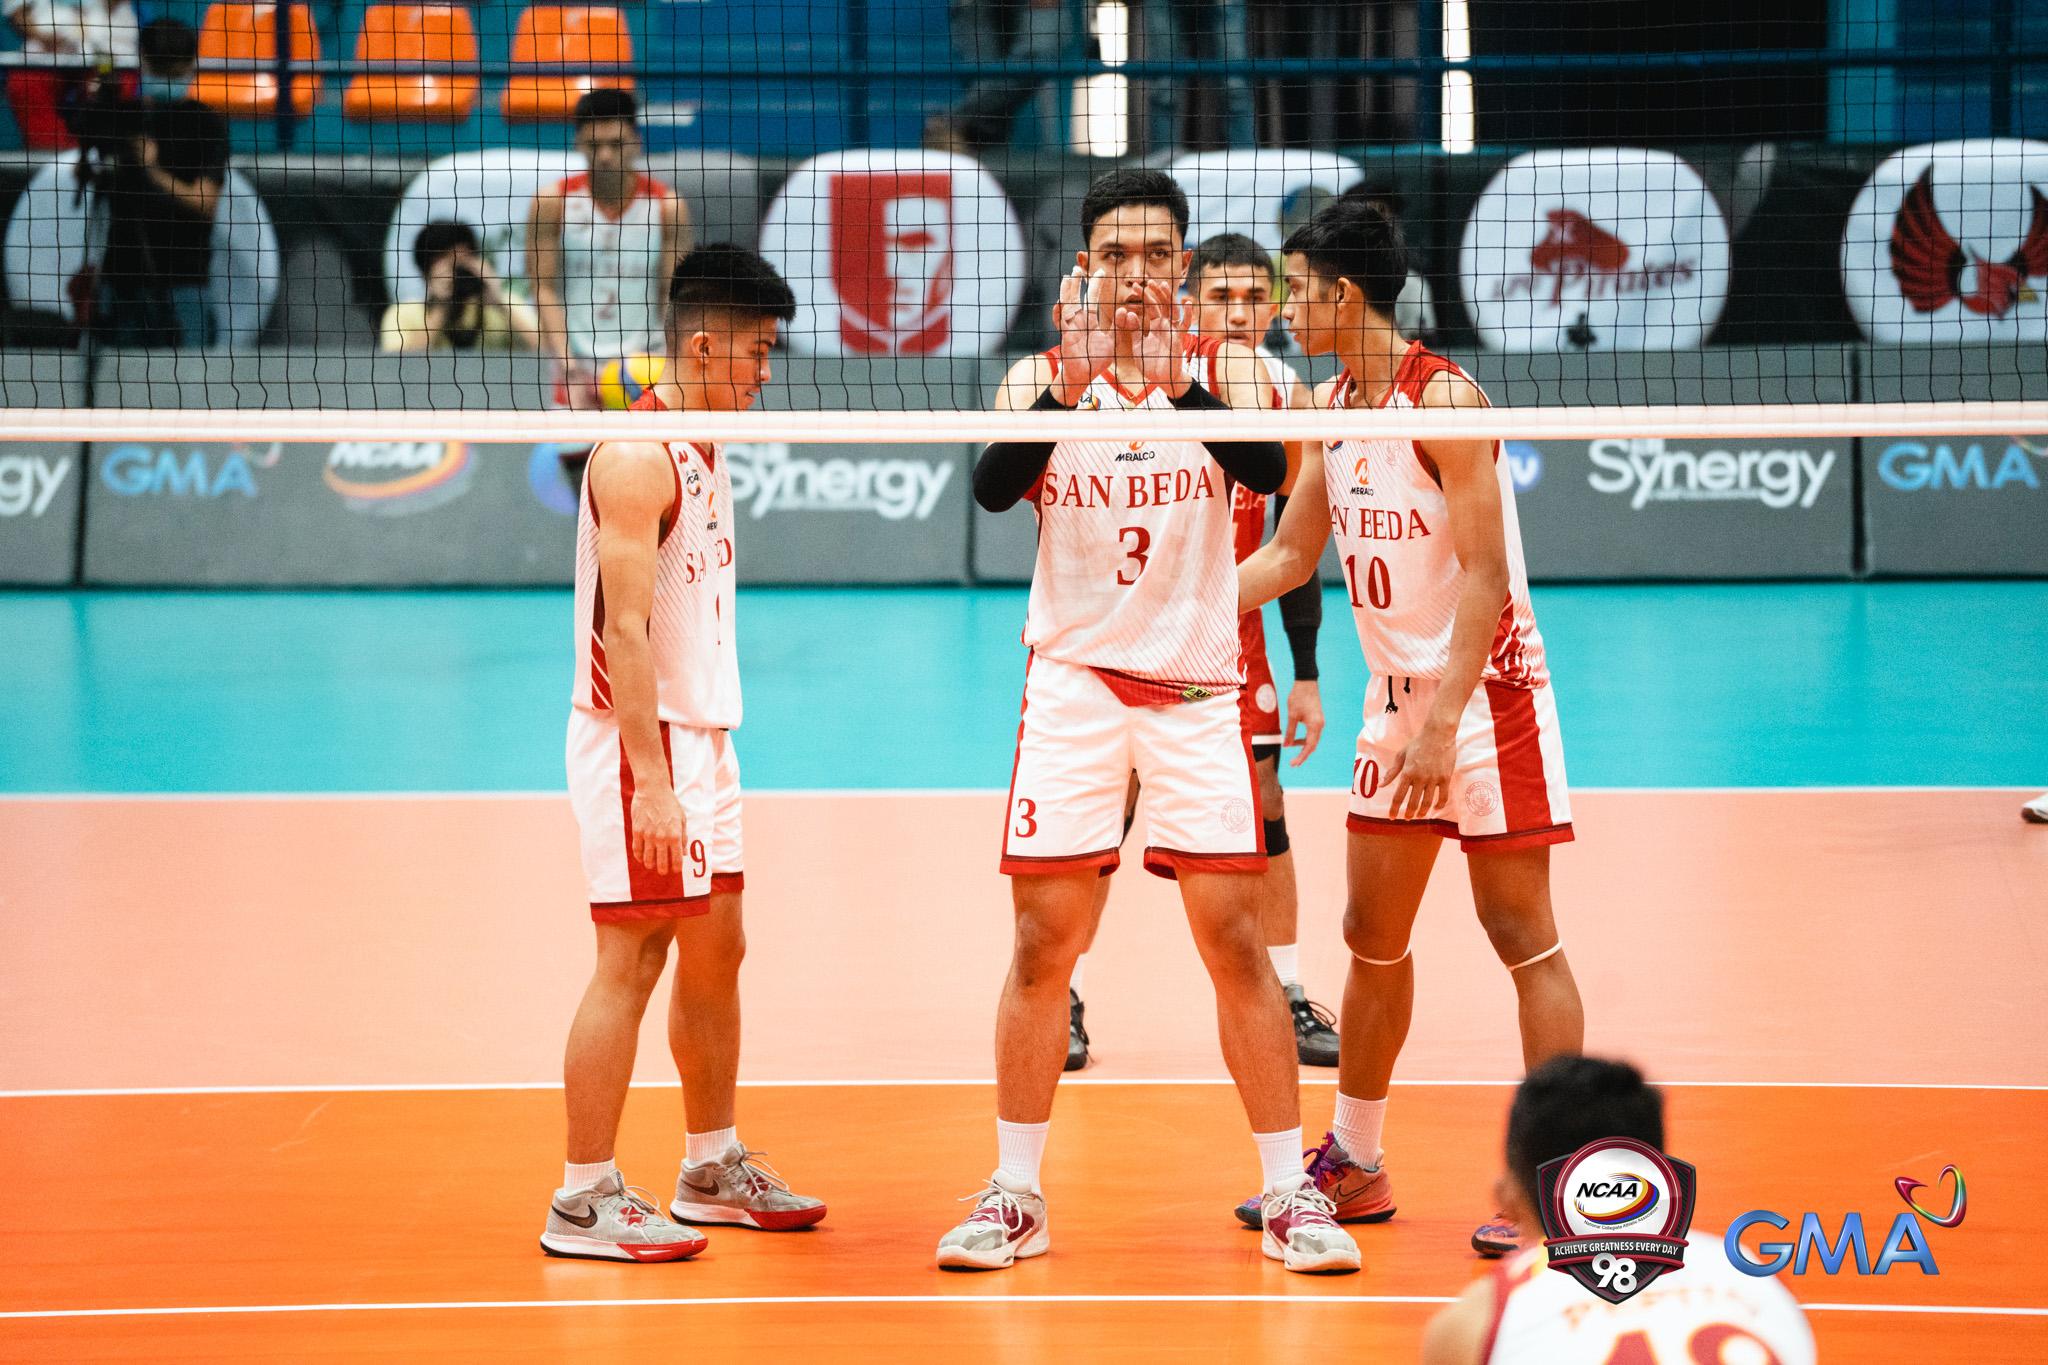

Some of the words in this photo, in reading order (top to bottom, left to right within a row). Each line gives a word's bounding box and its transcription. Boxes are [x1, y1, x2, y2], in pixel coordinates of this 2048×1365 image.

[102, 443, 257, 498] GMA
[728, 443, 954, 518] Synergy
[1115, 451, 1155, 462] MERALCO
[1588, 439, 1836, 510] Synergy
[1877, 441, 2040, 491] GMA
[1043, 472, 1114, 509] SAN
[1126, 465, 1215, 509] BEDA
[1358, 508, 1431, 541] BEDA
[1116, 526, 1151, 586] 3
[1345, 554, 1392, 610] 10
[1015, 798, 1038, 838] 3
[689, 839, 707, 878] 9
